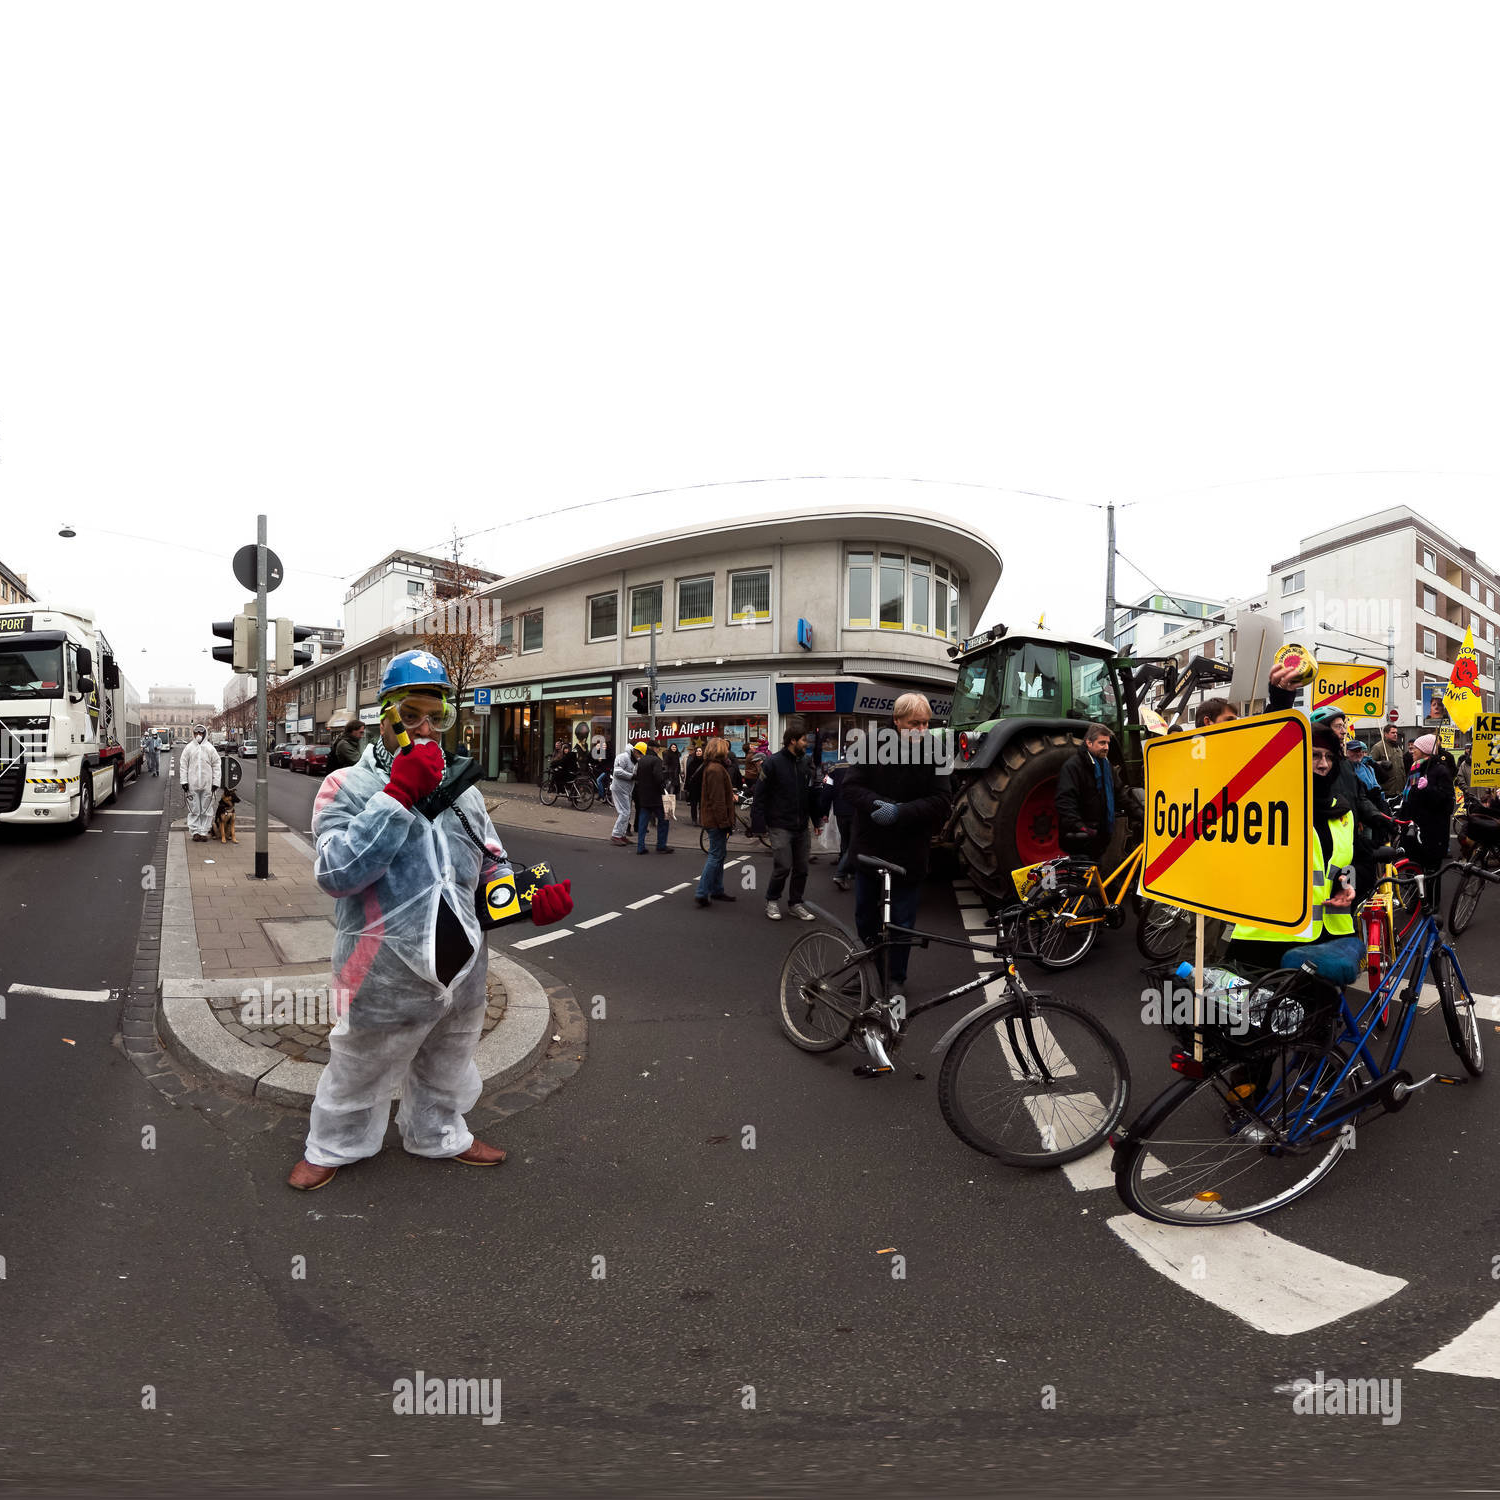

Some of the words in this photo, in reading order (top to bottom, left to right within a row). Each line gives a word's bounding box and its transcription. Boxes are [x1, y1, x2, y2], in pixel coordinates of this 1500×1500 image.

[700, 688, 757, 702] SCHMIDT
[1318, 678, 1380, 698] Gorleben
[662, 725, 676, 737] für
[1154, 786, 1289, 846] Gorleben
